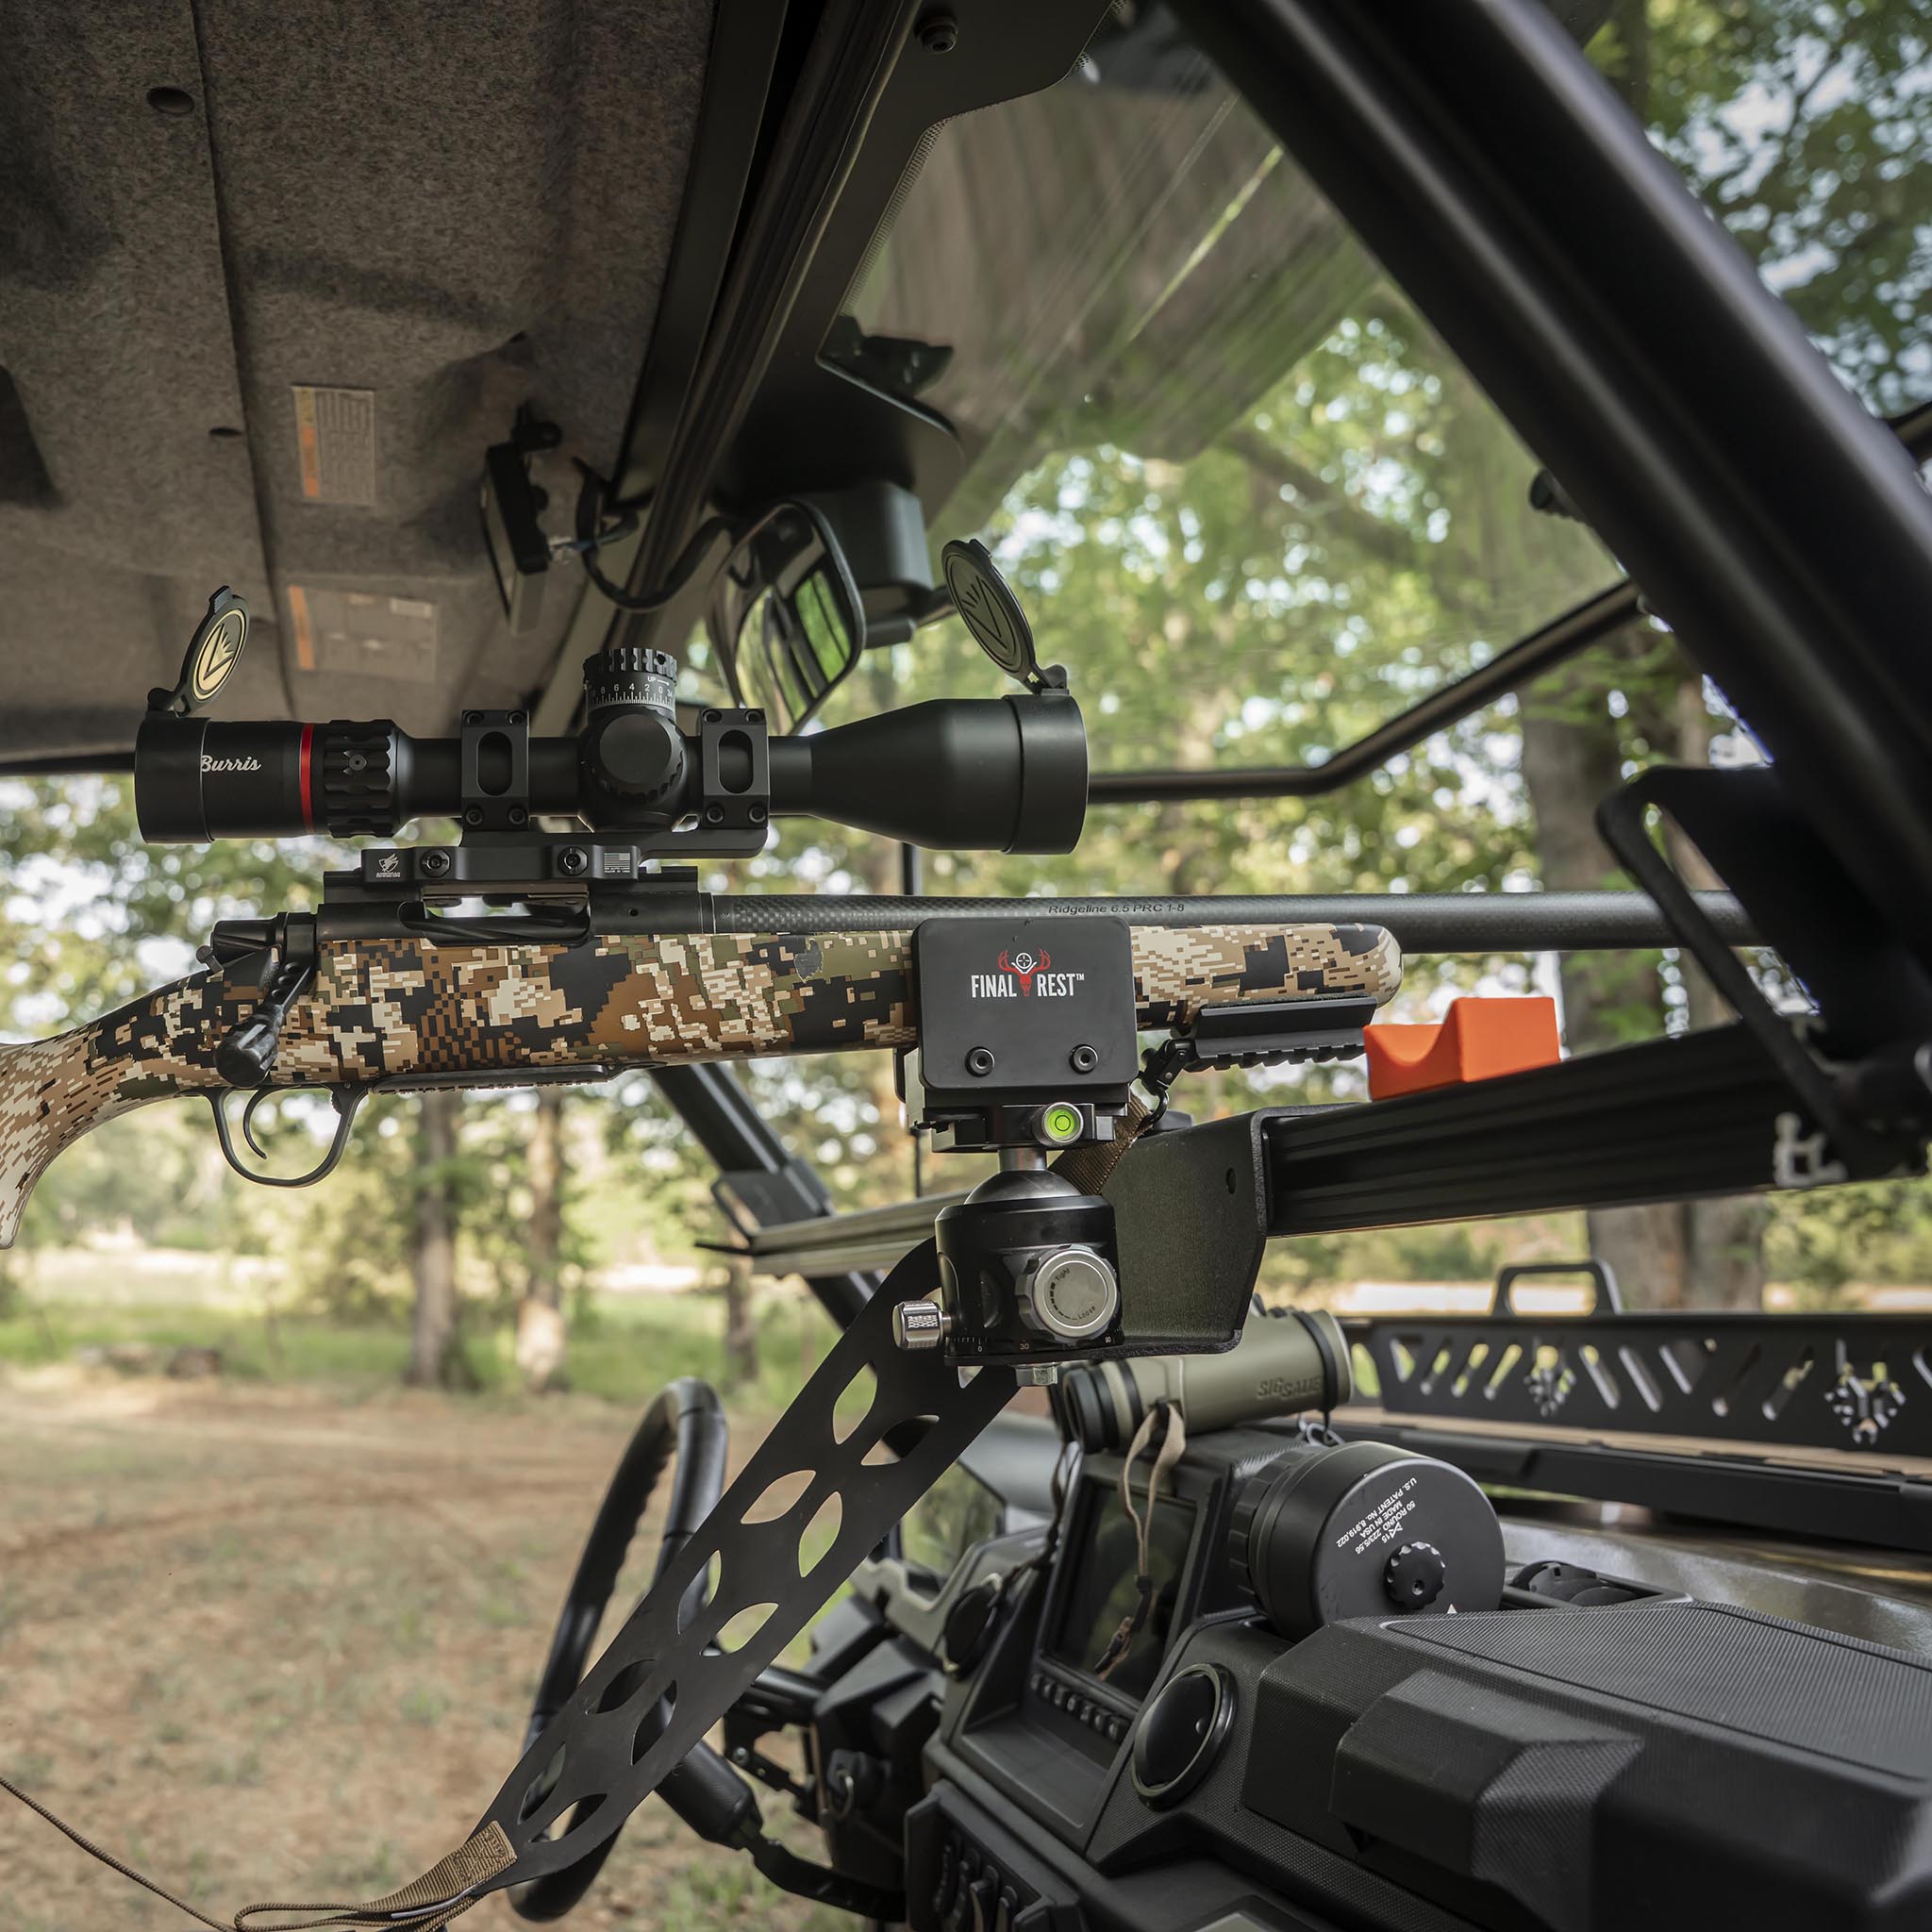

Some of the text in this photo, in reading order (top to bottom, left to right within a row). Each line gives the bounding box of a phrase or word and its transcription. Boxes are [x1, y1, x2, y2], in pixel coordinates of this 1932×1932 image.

[613, 683, 620, 691] 6
[628, 682, 635, 691] 4
[644, 683, 650, 691] 2
[658, 686, 663, 694] 0
[201, 754, 262, 773] Burris
[1048, 904, 1185, 916] Ridgeline 6.5 PRC 1-8
[971, 974, 1018, 998] FINAL
[1105, 1335, 1112, 1343] 90
[1336, 1477, 1418, 1548] U.S. PATENT No. 8,919,022
[1406, 1500, 1416, 1511] 50
[1359, 1500, 1404, 1539] MADE IN USA
[1382, 1507, 1407, 1531] ROUND
